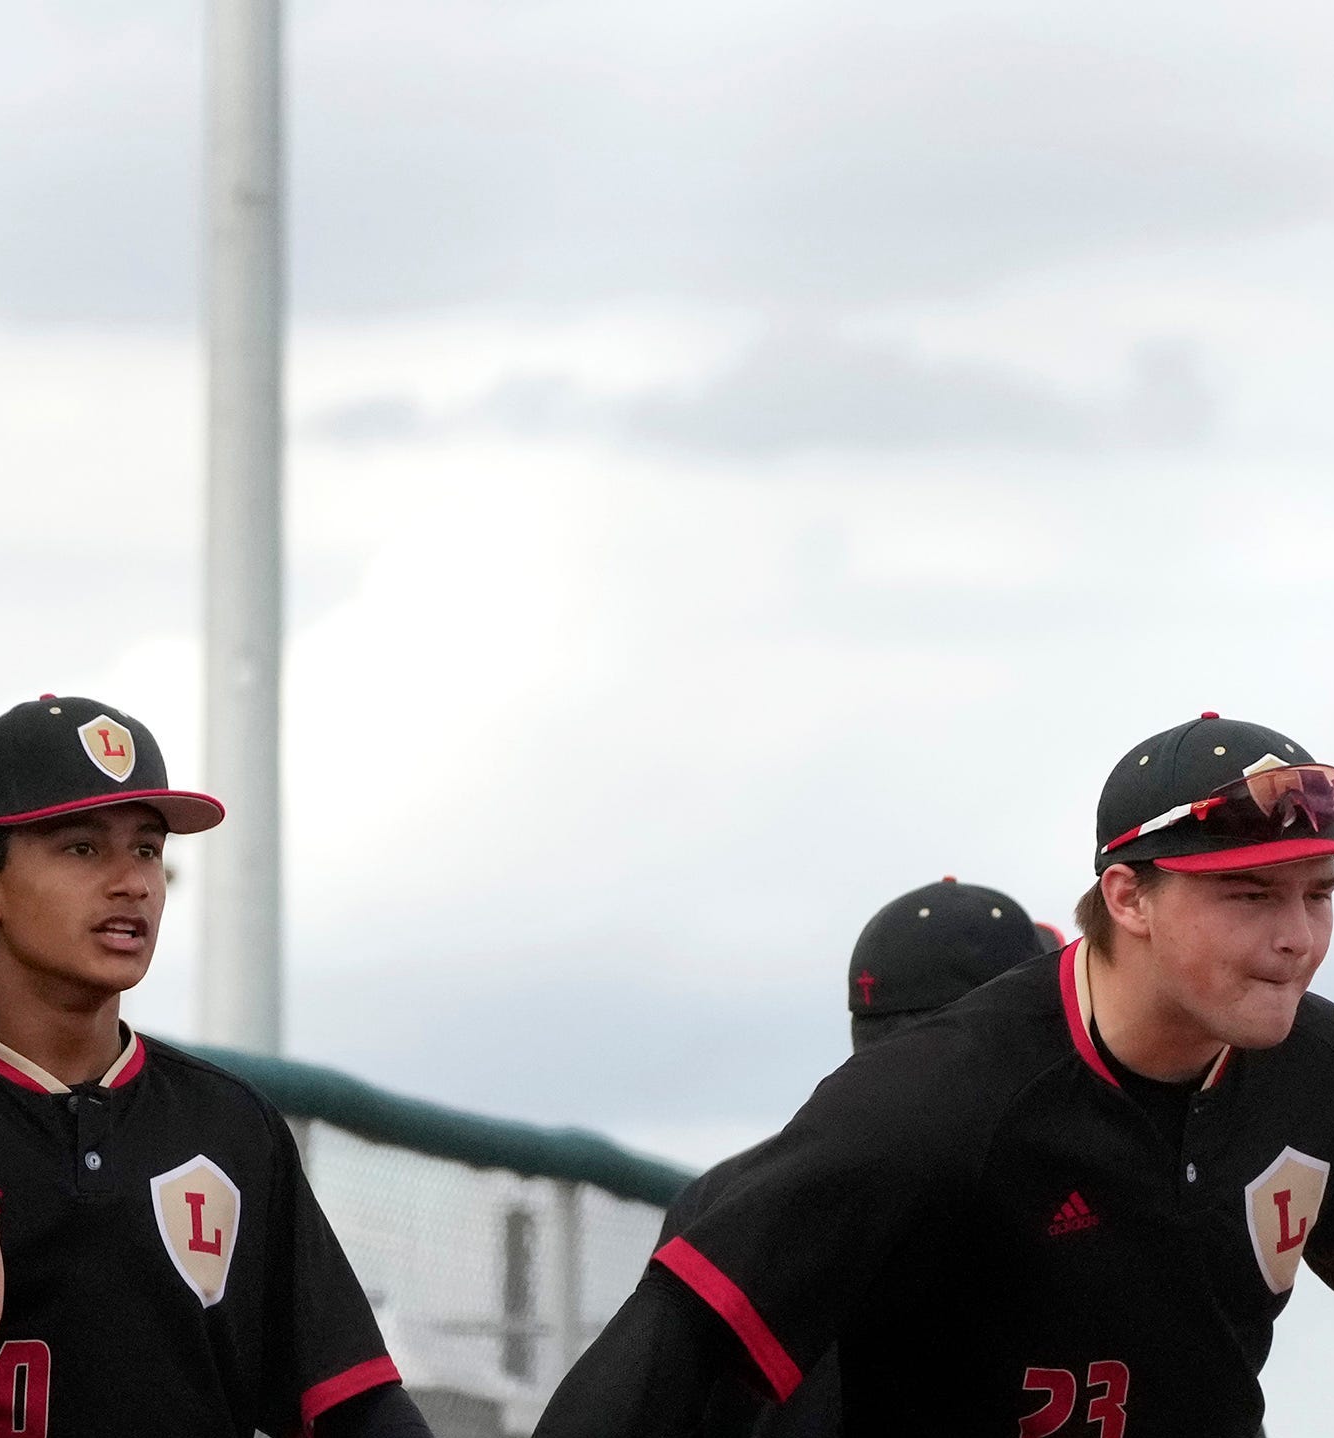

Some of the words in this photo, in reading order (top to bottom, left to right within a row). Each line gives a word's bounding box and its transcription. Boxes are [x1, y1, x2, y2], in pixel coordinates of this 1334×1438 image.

[97, 729, 125, 757] L
[184, 1192, 222, 1257] L
[1048, 1214, 1099, 1236] adidas
[1271, 1189, 1306, 1257] L
